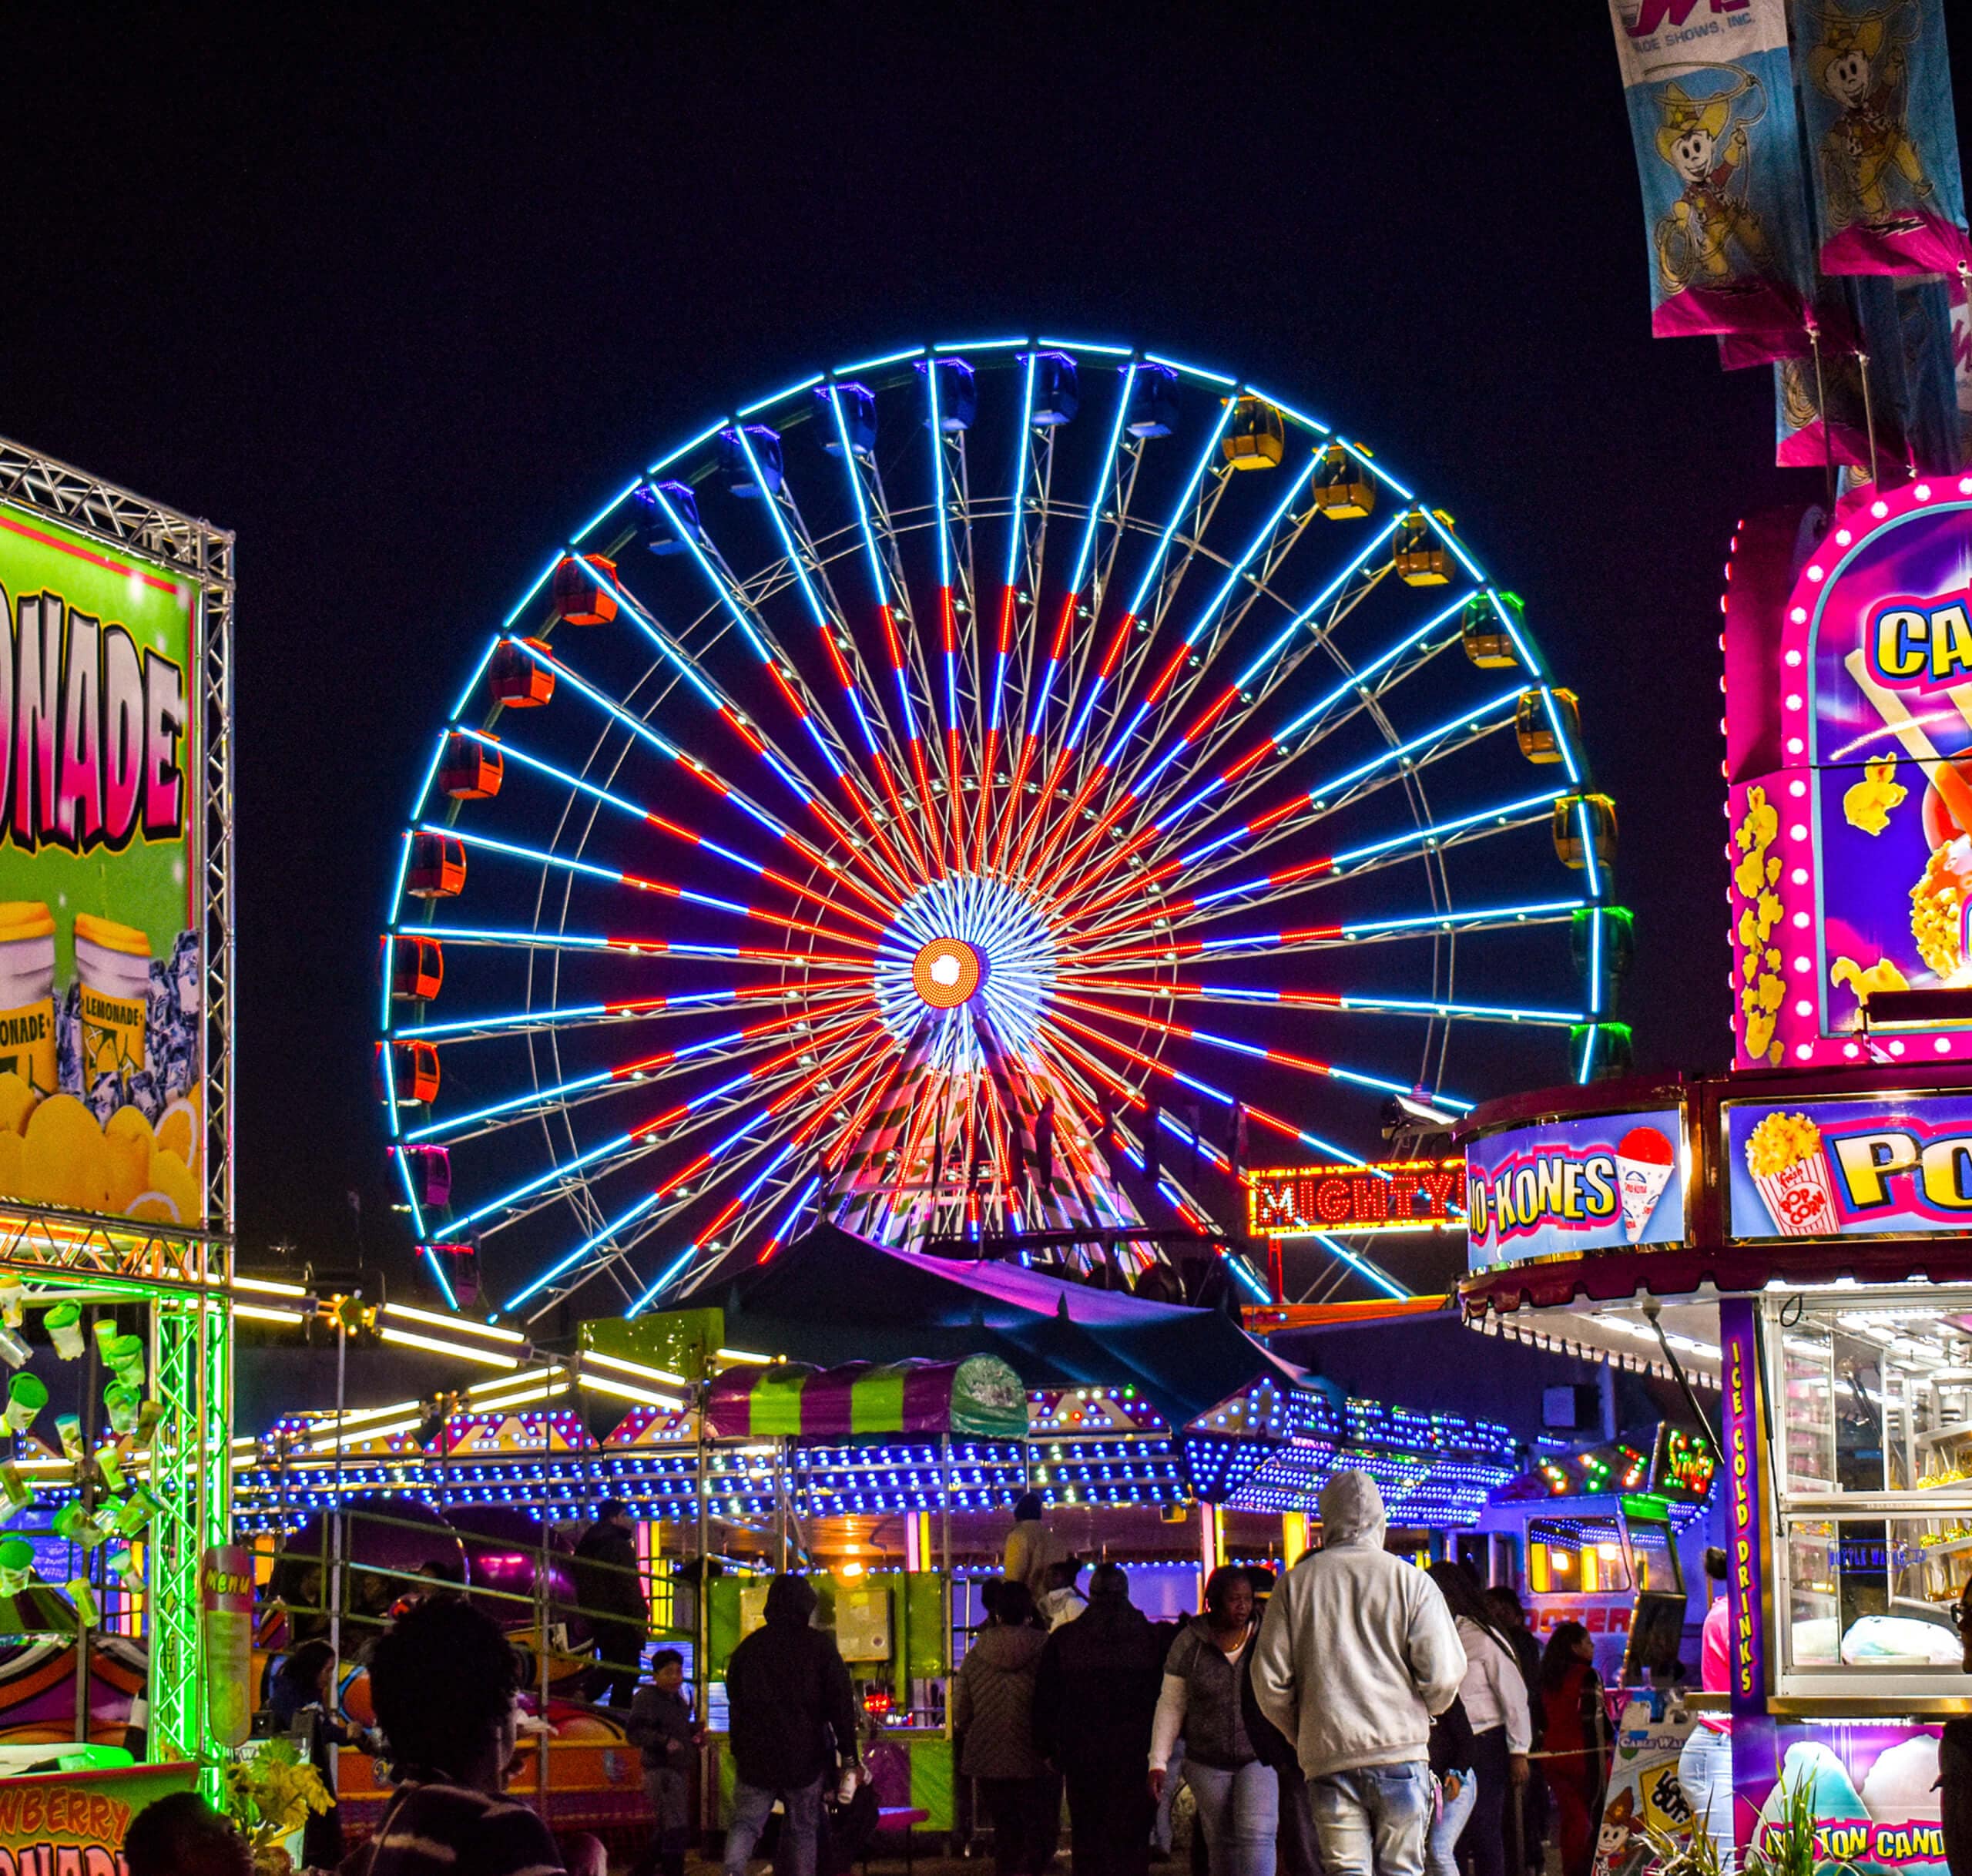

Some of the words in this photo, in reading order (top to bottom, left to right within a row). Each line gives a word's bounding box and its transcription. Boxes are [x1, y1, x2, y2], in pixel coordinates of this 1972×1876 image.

[1665, 21, 1725, 47] SHOWS,
[1727, 12, 1756, 29] INC.
[1877, 604, 1972, 678] CA
[86, 995, 140, 1027] LEMONADE
[1832, 1132, 1972, 1211] PO
[1259, 1172, 1454, 1223] MIGHTY
[1779, 1188, 1809, 1213] POP
[1789, 1190, 1826, 1225] CORN
[1731, 1341, 1744, 1415] ICE
[1733, 1428, 1749, 1529] COLD
[205, 1569, 250, 1596] Menu
[1737, 1539, 1752, 1692] DRINKS
[1876, 1826, 1946, 1861] CAND
